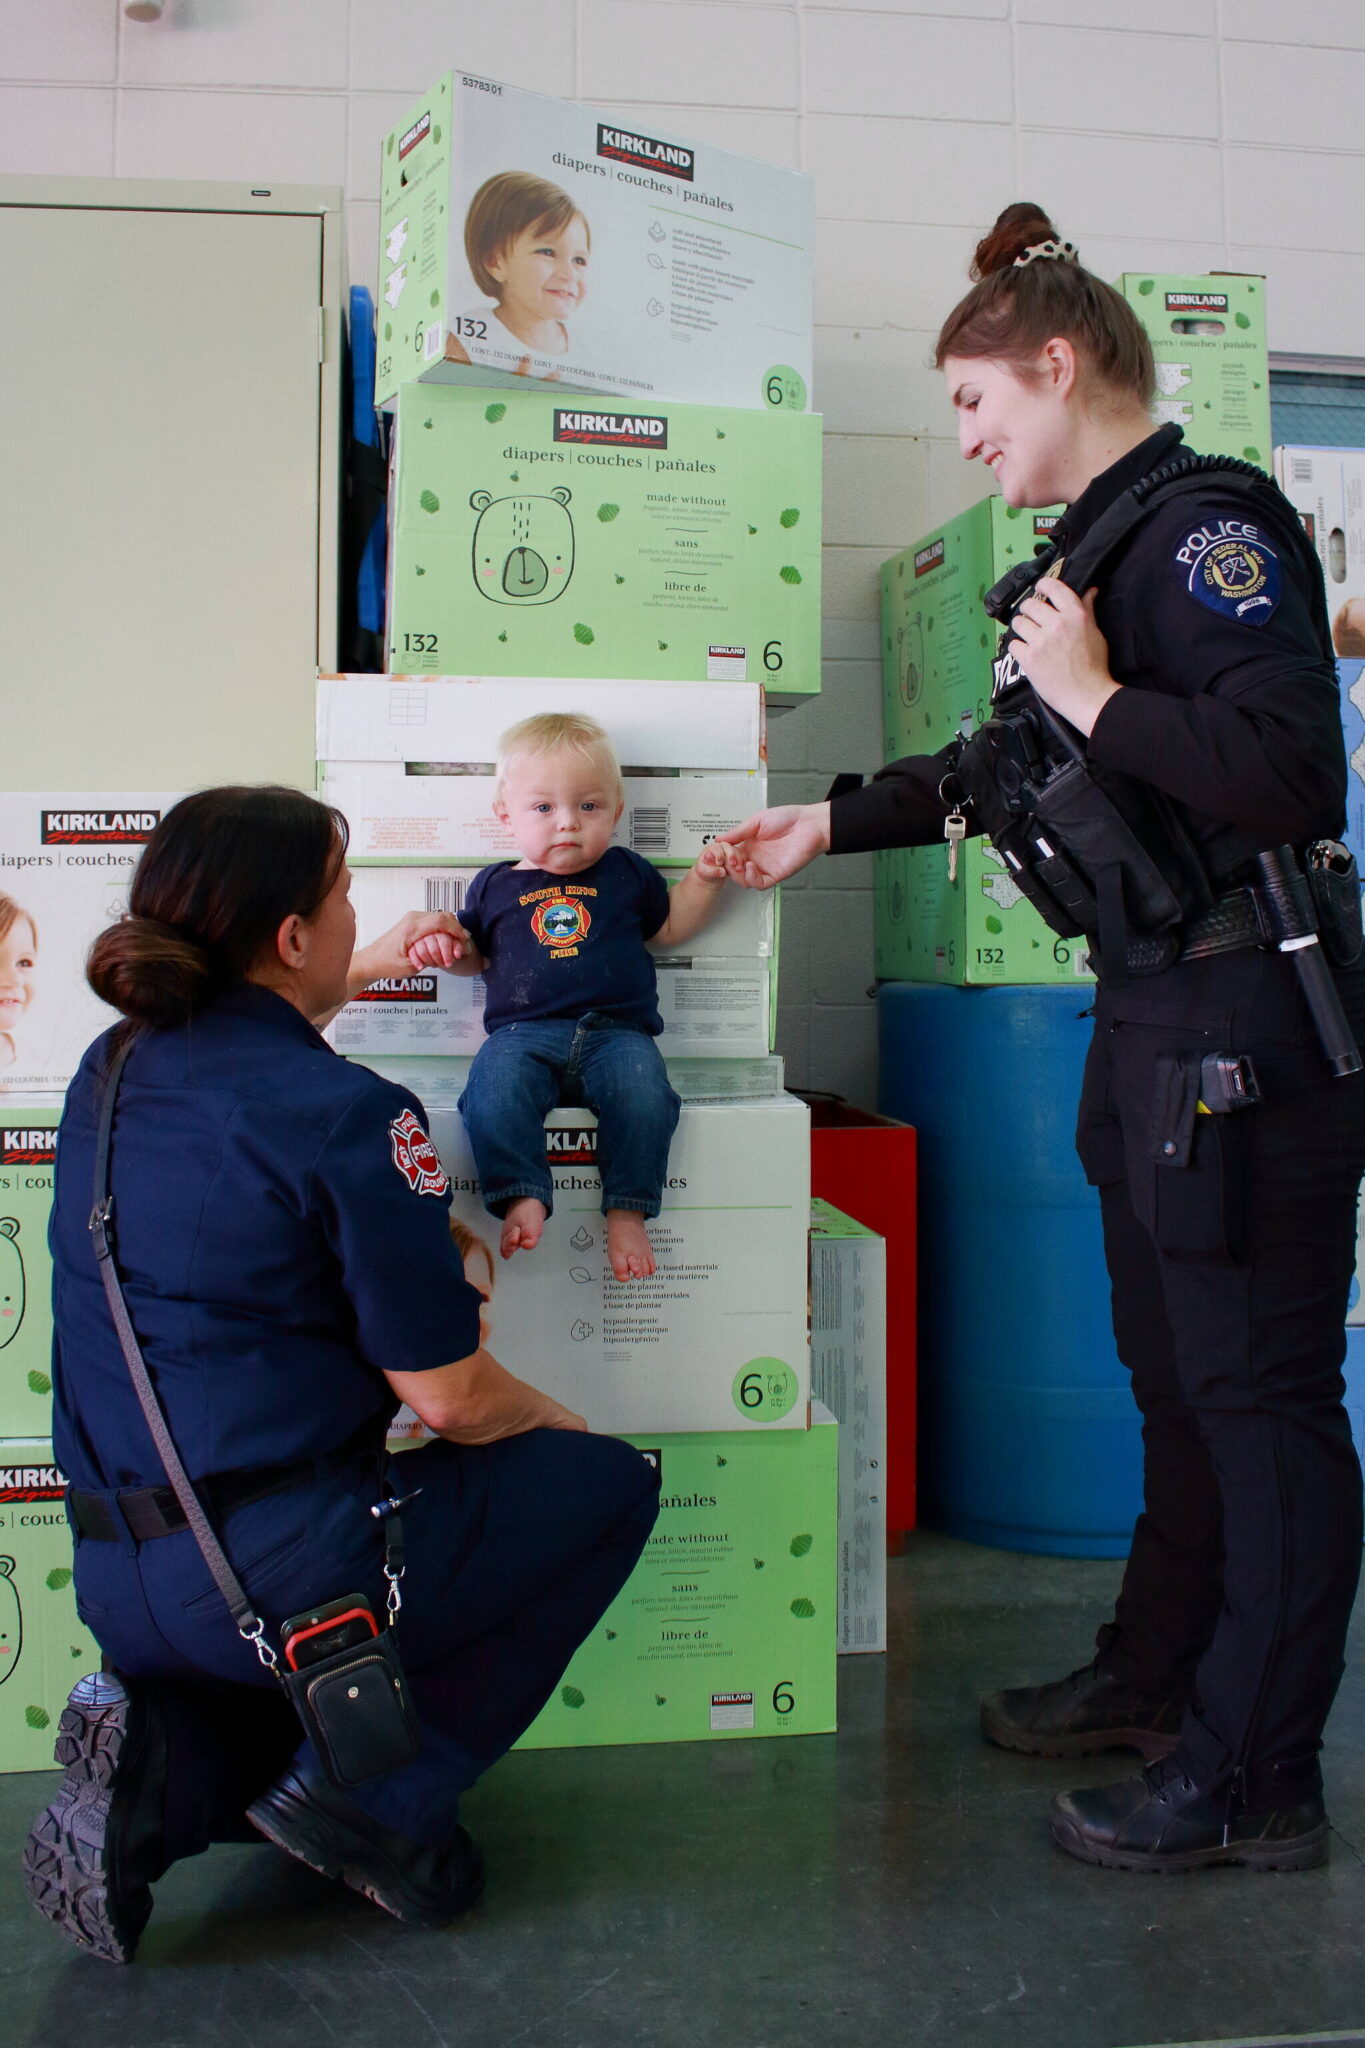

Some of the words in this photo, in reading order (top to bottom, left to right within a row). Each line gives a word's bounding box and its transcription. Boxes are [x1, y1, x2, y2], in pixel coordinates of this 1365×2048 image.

[602, 128, 691, 168] KIRKLAND
[552, 152, 606, 177] diapers
[617, 170, 673, 195] couches
[683, 188, 734, 212] pañales
[1168, 294, 1227, 306] KIRKLAND
[414, 321, 423, 352] 6
[455, 317, 488, 340] 132
[1180, 340, 1217, 348] couches
[767, 376, 783, 405] 6
[560, 413, 664, 436] KIRKLAND
[559, 430, 664, 444] Signature
[503, 447, 565, 463] diapers
[577, 452, 642, 468] couches
[656, 458, 716, 474] pañales
[646, 493, 678, 503] made
[681, 496, 726, 506] without
[674, 540, 699, 548] sans
[1176, 521, 1258, 564] POLICE
[1212, 543, 1248, 556] FEDERAL
[916, 542, 944, 568] KIRKLAND
[1205, 556, 1213, 566] OF
[1250, 550, 1265, 565] WAY
[1204, 569, 1214, 585] CITY
[664, 581, 691, 591] libre
[693, 583, 707, 592] de
[1221, 575, 1267, 598] WASHINGTON
[404, 633, 438, 652] 132
[710, 646, 745, 655] KIRKLAND
[763, 641, 783, 671] 6
[977, 698, 984, 724] 6
[47, 814, 156, 831] KIRKLAND
[47, 830, 152, 845] Signature
[1, 853, 53, 869] iapers
[67, 853, 135, 866] couches
[519, 887, 561, 906] SOUTH
[565, 885, 598, 897] KING
[550, 947, 579, 959] FIRE
[949, 940, 955, 966] 6
[976, 948, 1004, 964] 132
[1053, 938, 1070, 964] 6
[364, 977, 434, 991] RKLAND
[339, 1006, 367, 1016] iapers
[373, 1006, 409, 1015] couches
[415, 1006, 448, 1016] pañales
[4, 1131, 58, 1150] KIRK
[411, 1142, 434, 1161] FIRE
[553, 1176, 601, 1190] uches
[603, 1317, 659, 1326] hypoallergenic
[740, 1374, 763, 1408] 6
[0, 1468, 70, 1488] KIRKL
[660, 1493, 717, 1508] añales
[21, 1513, 65, 1526] couc
[647, 1534, 674, 1545] ade
[678, 1533, 729, 1544] without
[672, 1584, 699, 1592] sans
[661, 1631, 691, 1641] libre
[694, 1630, 708, 1639] de
[713, 1694, 751, 1702] KIRKLAND
[773, 1681, 795, 1714] 6
